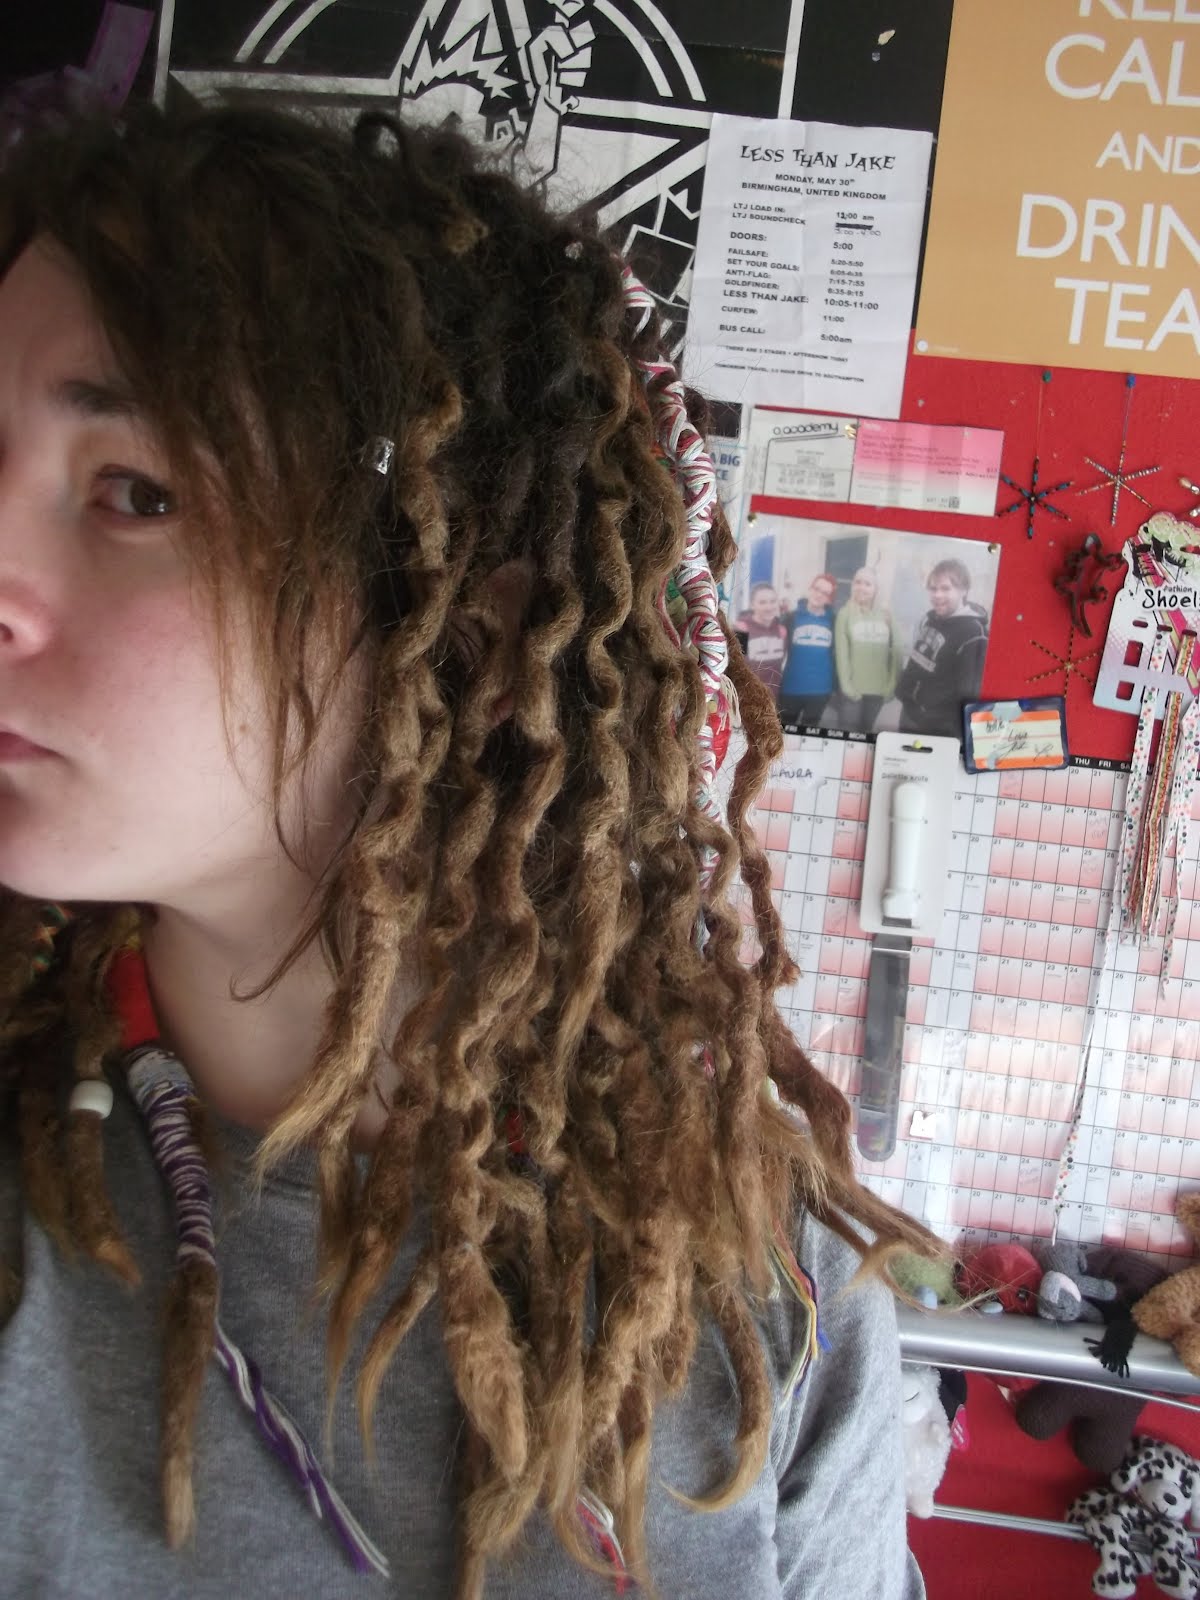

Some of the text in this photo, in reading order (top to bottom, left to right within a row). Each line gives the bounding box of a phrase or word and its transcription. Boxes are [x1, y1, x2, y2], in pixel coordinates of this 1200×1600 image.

[740, 145, 896, 172] LESS THAN JAKE
[1096, 131, 1200, 175] AND
[775, 173, 815, 185] MONDAY,
[817, 177, 836, 185] MAY
[741, 182, 886, 200] BIRMINGHAM, UNITED KINGDOM
[733, 202, 748, 210] LTJ
[750, 204, 772, 212] LOAD
[749, 213, 806, 225] SOUNDCHECK
[730, 231, 767, 241] DOORS:
[728, 247, 769, 257] FAILSAFE:
[833, 241, 854, 251] 5:00
[745, 260, 768, 268] YOUR
[770, 262, 800, 272] GOALS:
[725, 268, 772, 279] ANTI-FLAG:
[724, 278, 780, 290] GOLDFINGER:
[723, 289, 809, 303] LESS THAN JAKE:
[822, 314, 845, 323] 11:00
[1054, 277, 1200, 355] TEA
[719, 324, 766, 334] BUS CALL:
[720, 453, 740, 467] BIG
[1142, 588, 1200, 609] Shoel
[784, 724, 799, 733] FRI
[805, 726, 820, 735] SAT
[827, 729, 844, 738] SUN
[849, 731, 867, 740] MON
[1074, 757, 1091, 767] THU
[1098, 759, 1112, 769] FRI
